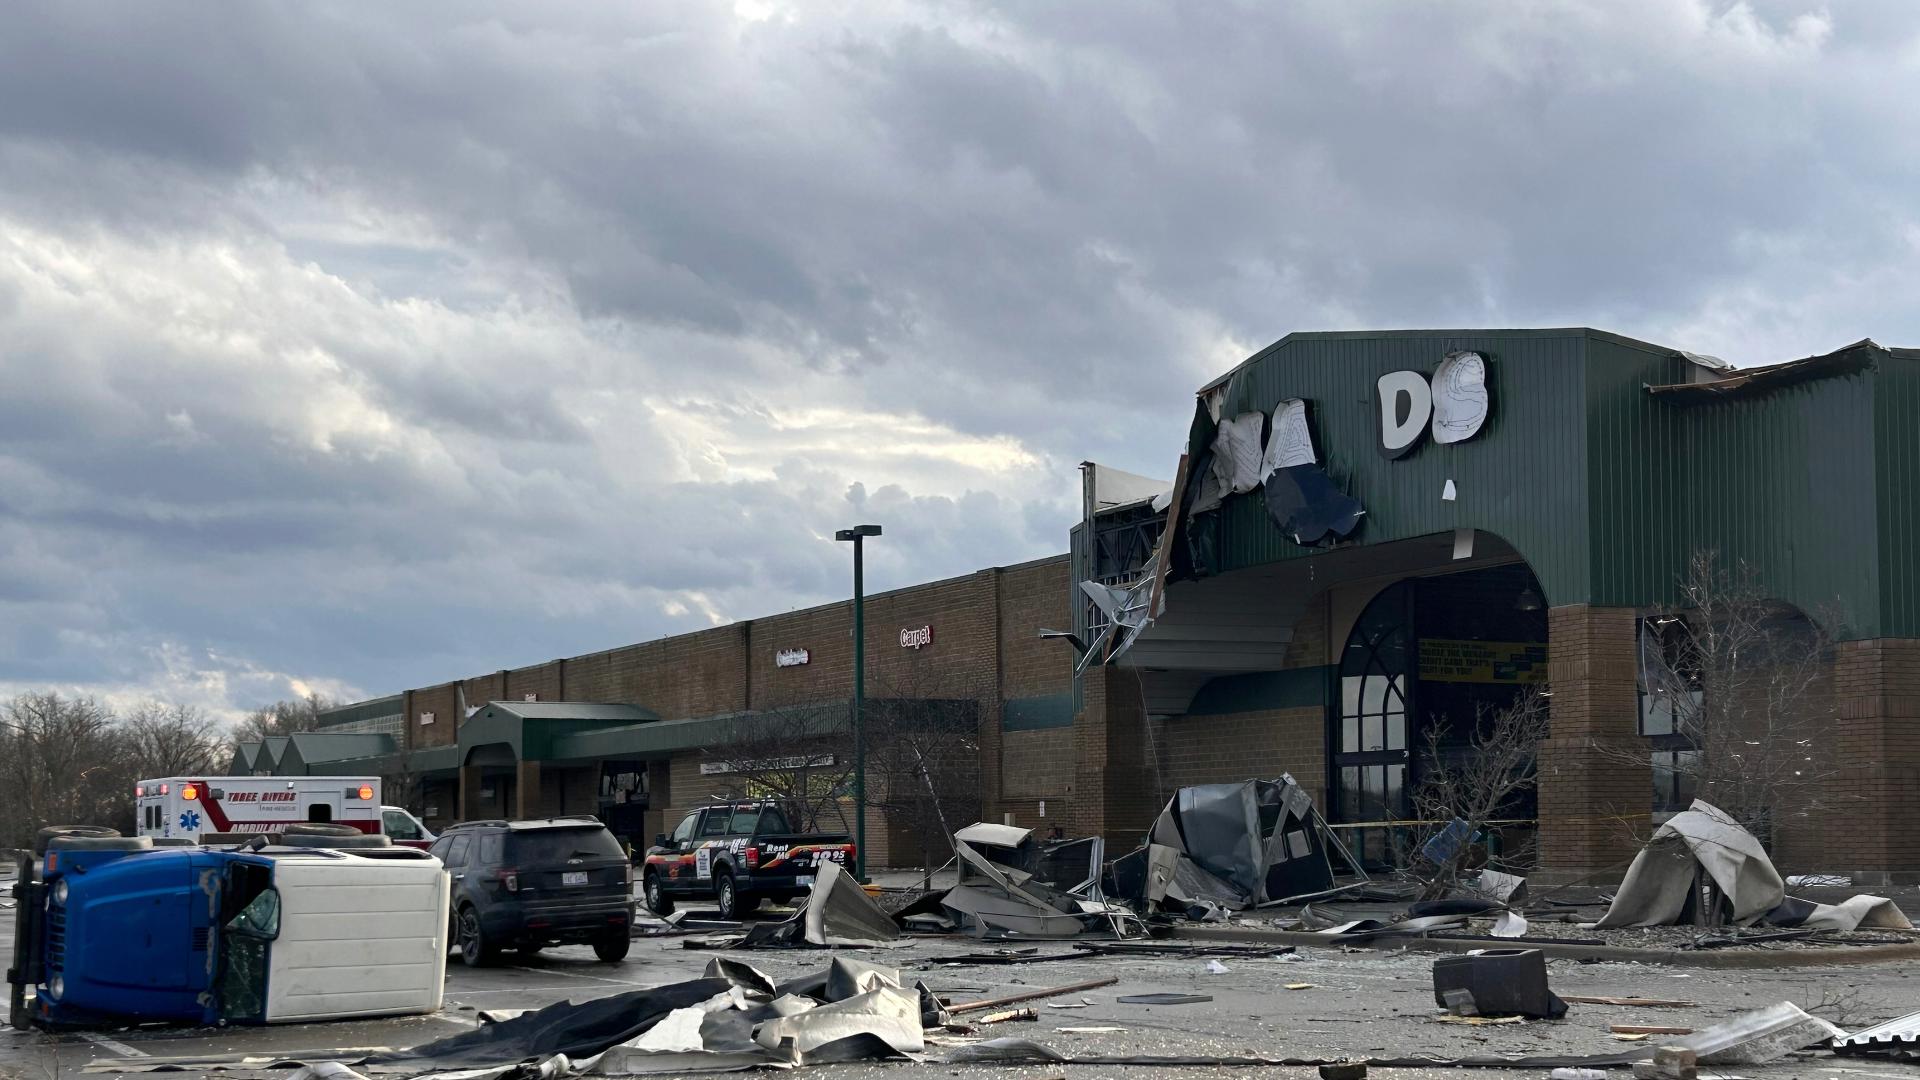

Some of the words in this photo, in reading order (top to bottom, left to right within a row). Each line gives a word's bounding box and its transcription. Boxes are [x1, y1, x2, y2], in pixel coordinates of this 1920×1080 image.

[900, 625, 931, 649] Carpet
[228, 792, 258, 801] THREE
[261, 792, 297, 801] RIVERS
[230, 823, 289, 833] AMBULAN
[766, 844, 789, 852] Rent
